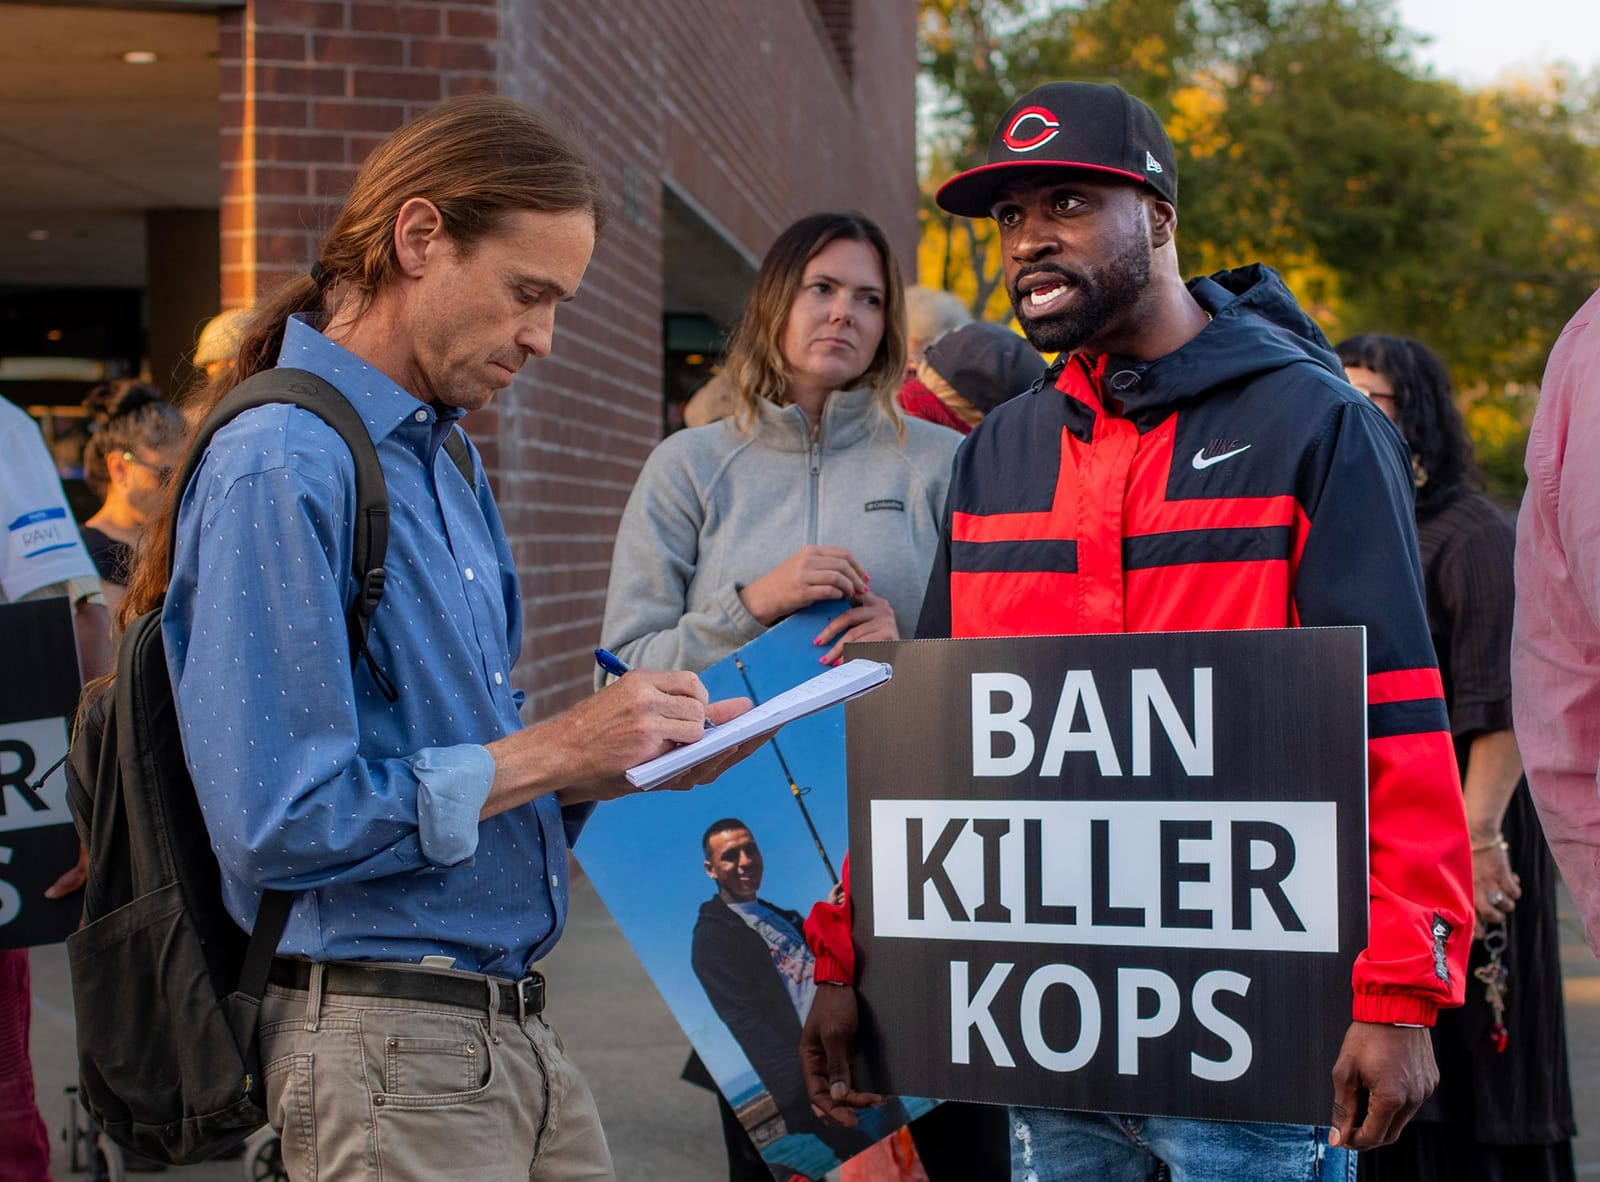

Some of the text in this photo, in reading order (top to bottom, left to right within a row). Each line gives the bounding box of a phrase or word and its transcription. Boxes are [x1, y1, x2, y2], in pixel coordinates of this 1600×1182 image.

[22, 525, 61, 547] RAVI
[971, 667, 1214, 777] BAN
[905, 817, 1307, 933] KILLER
[950, 960, 1253, 1082] KOPS
